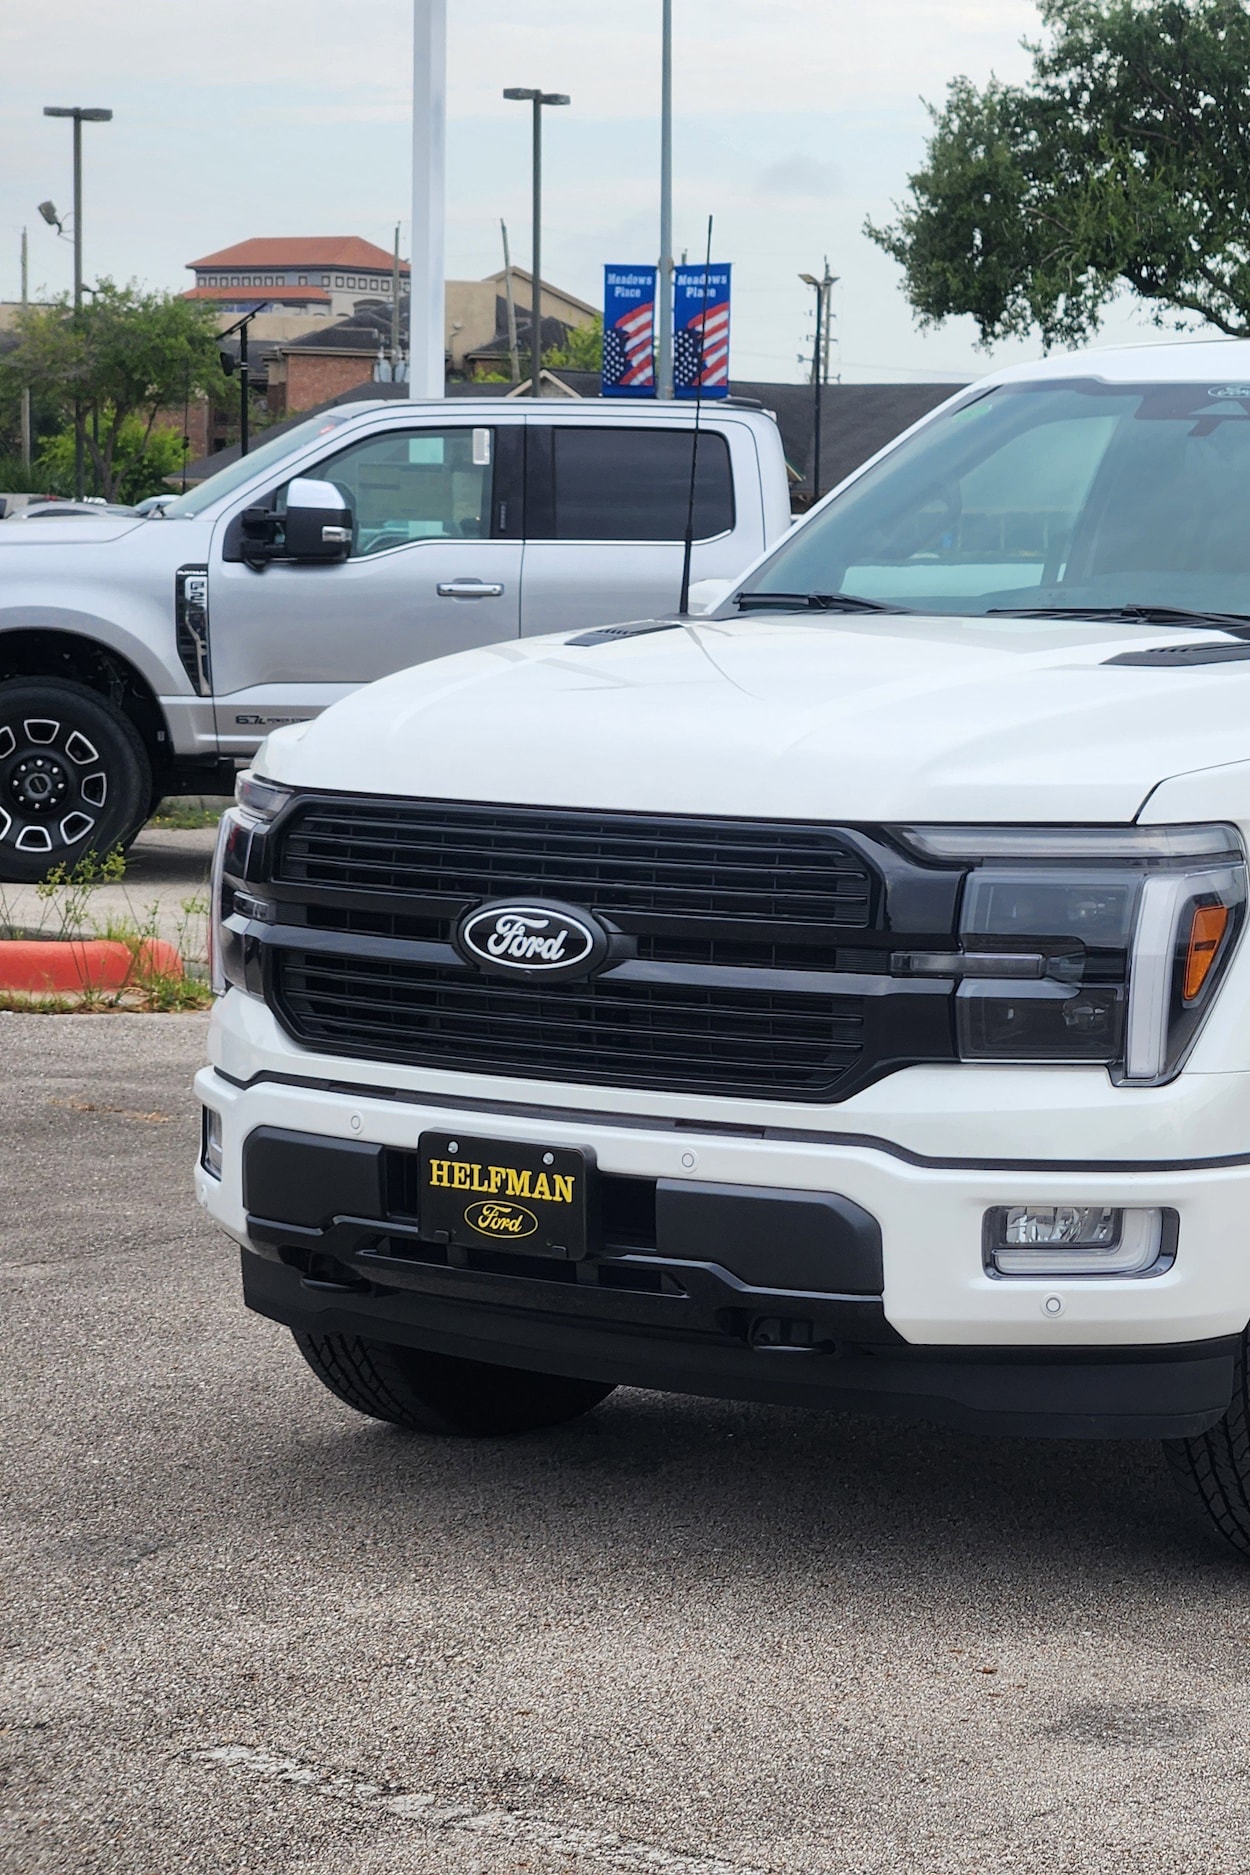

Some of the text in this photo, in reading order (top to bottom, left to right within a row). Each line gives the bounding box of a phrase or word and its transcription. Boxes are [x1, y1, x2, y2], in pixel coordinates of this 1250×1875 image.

[607, 273, 653, 285] Meadows
[614, 286, 641, 298] Place
[487, 914, 568, 961] Ford
[429, 1159, 575, 1203] HELFMAN
[477, 1203, 524, 1232] Ford
